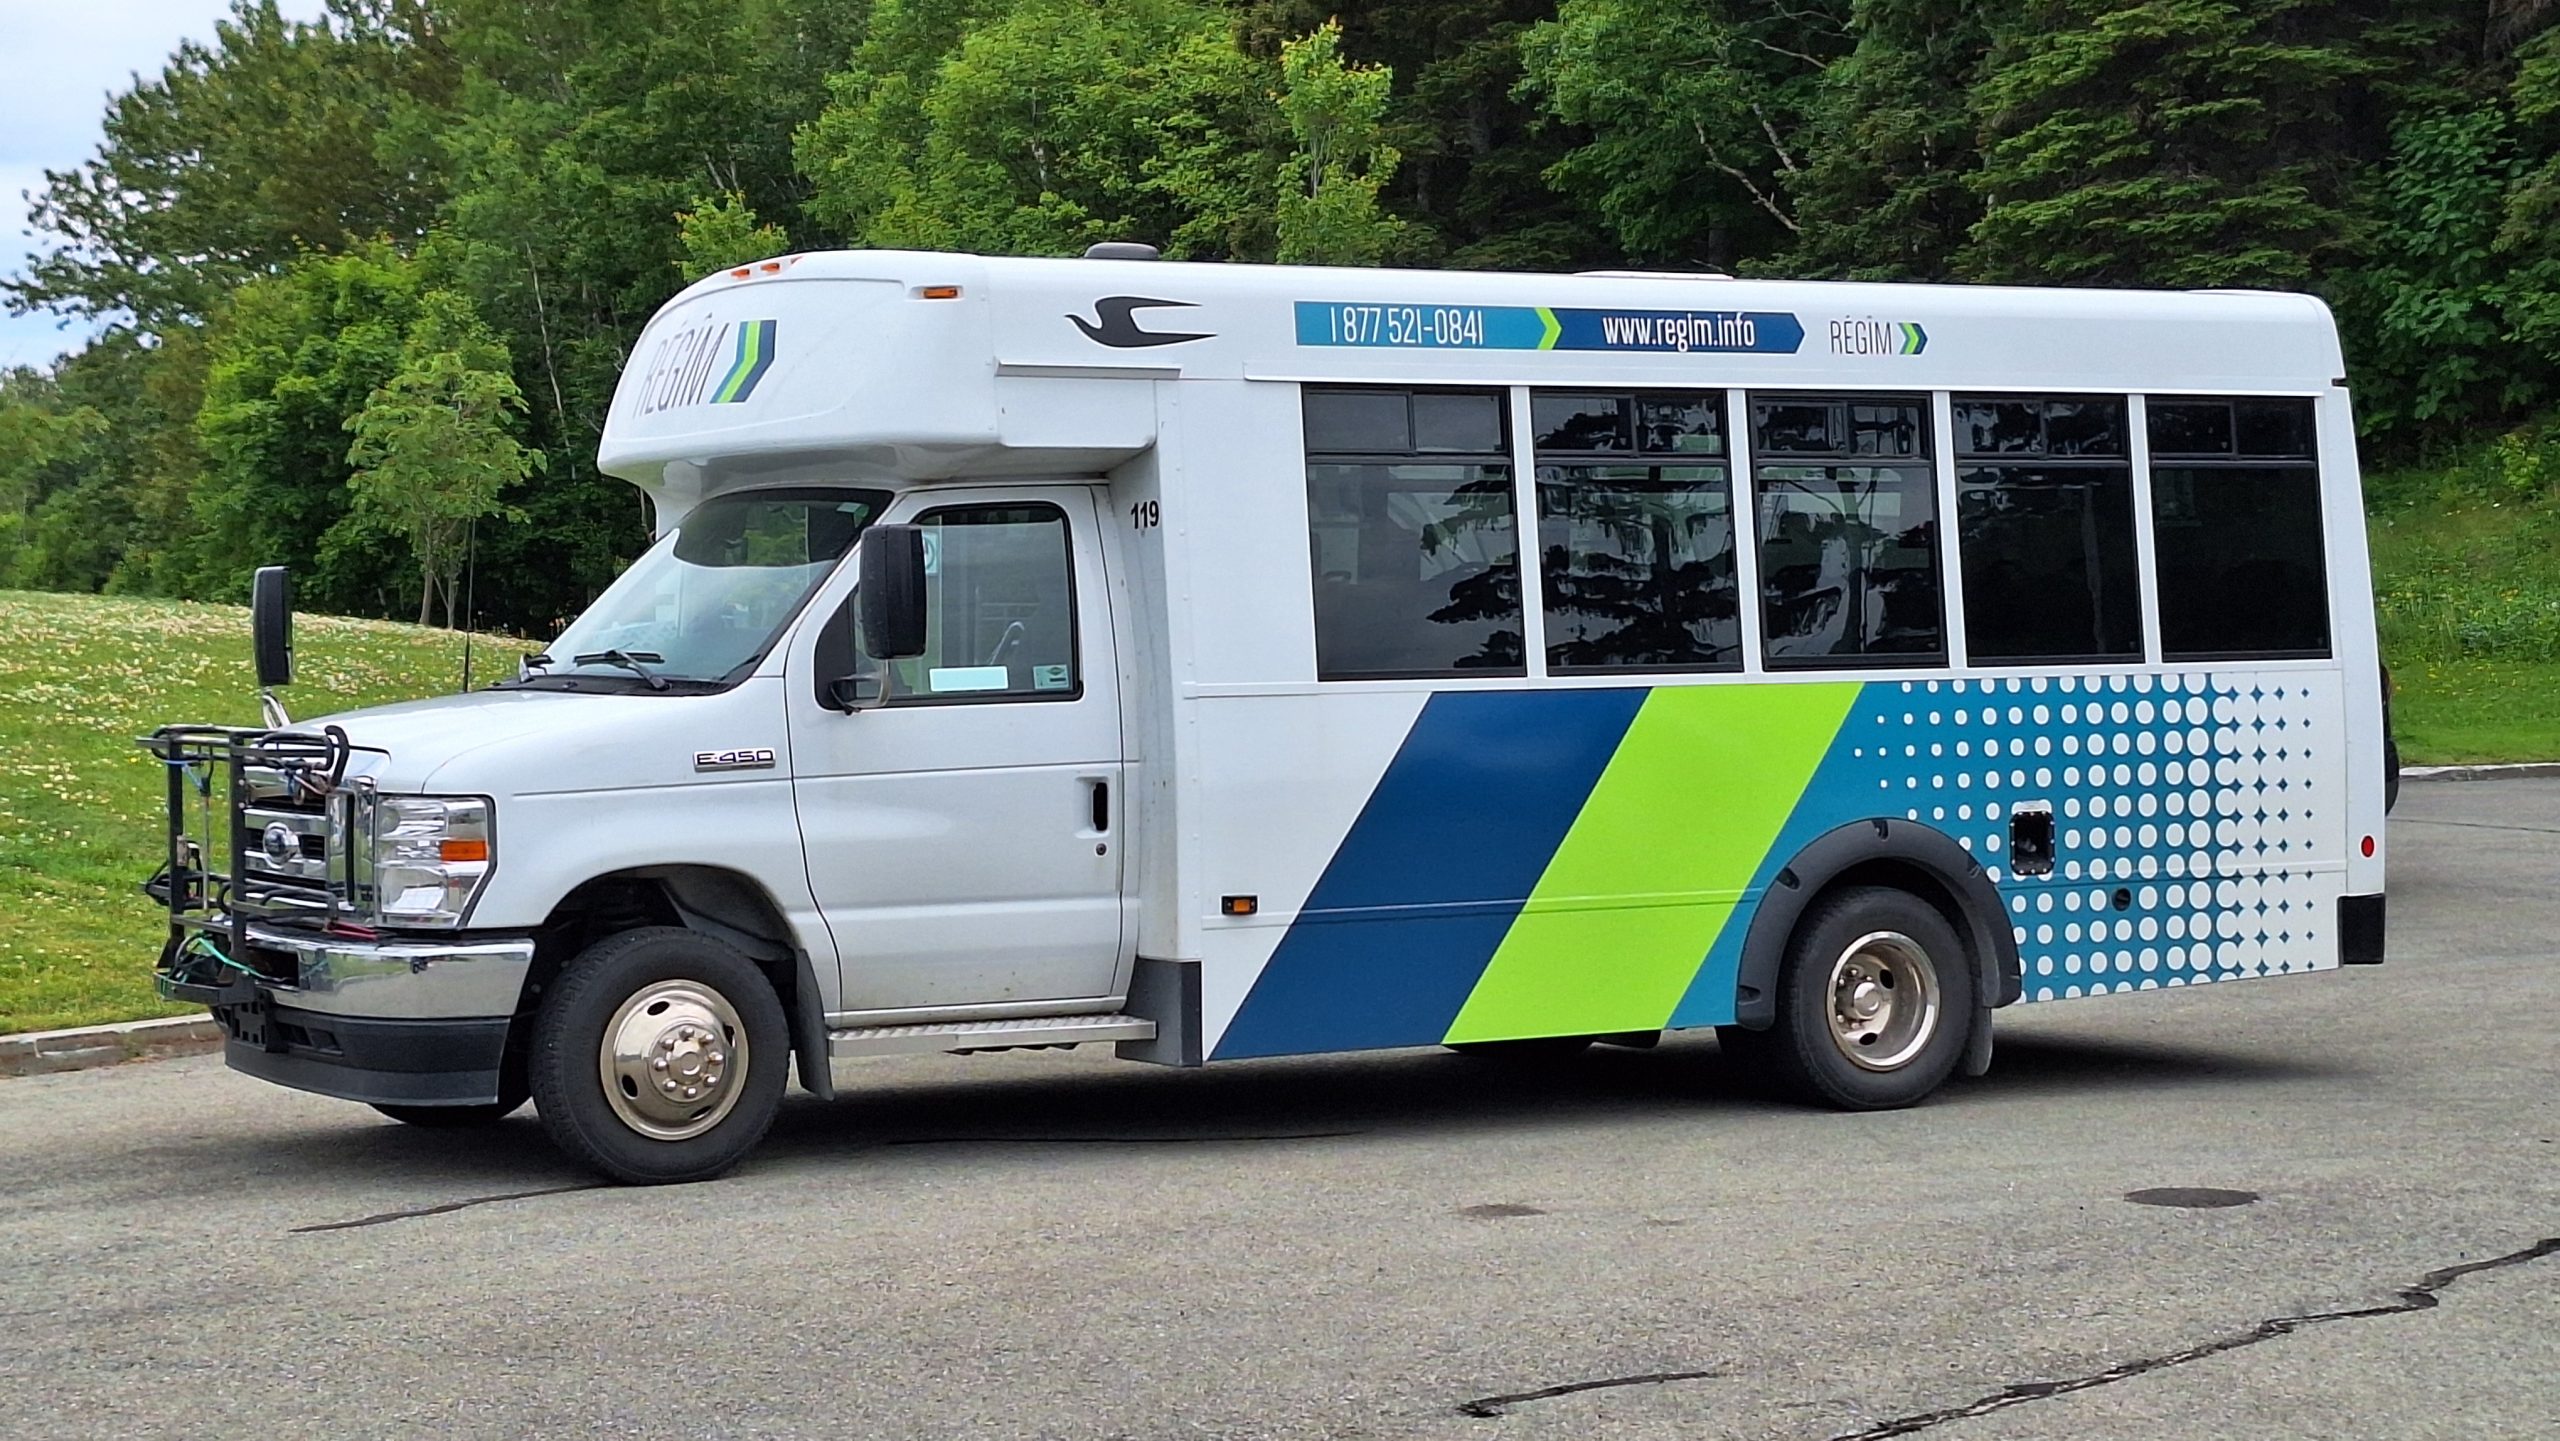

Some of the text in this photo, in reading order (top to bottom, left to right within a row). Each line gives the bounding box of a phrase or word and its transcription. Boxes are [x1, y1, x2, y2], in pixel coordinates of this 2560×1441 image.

[1343, 306, 1381, 343] 877
[1388, 308, 1484, 345] 521-0841
[1602, 311, 1756, 352] www.regim.info
[1130, 500, 1160, 530] 119
